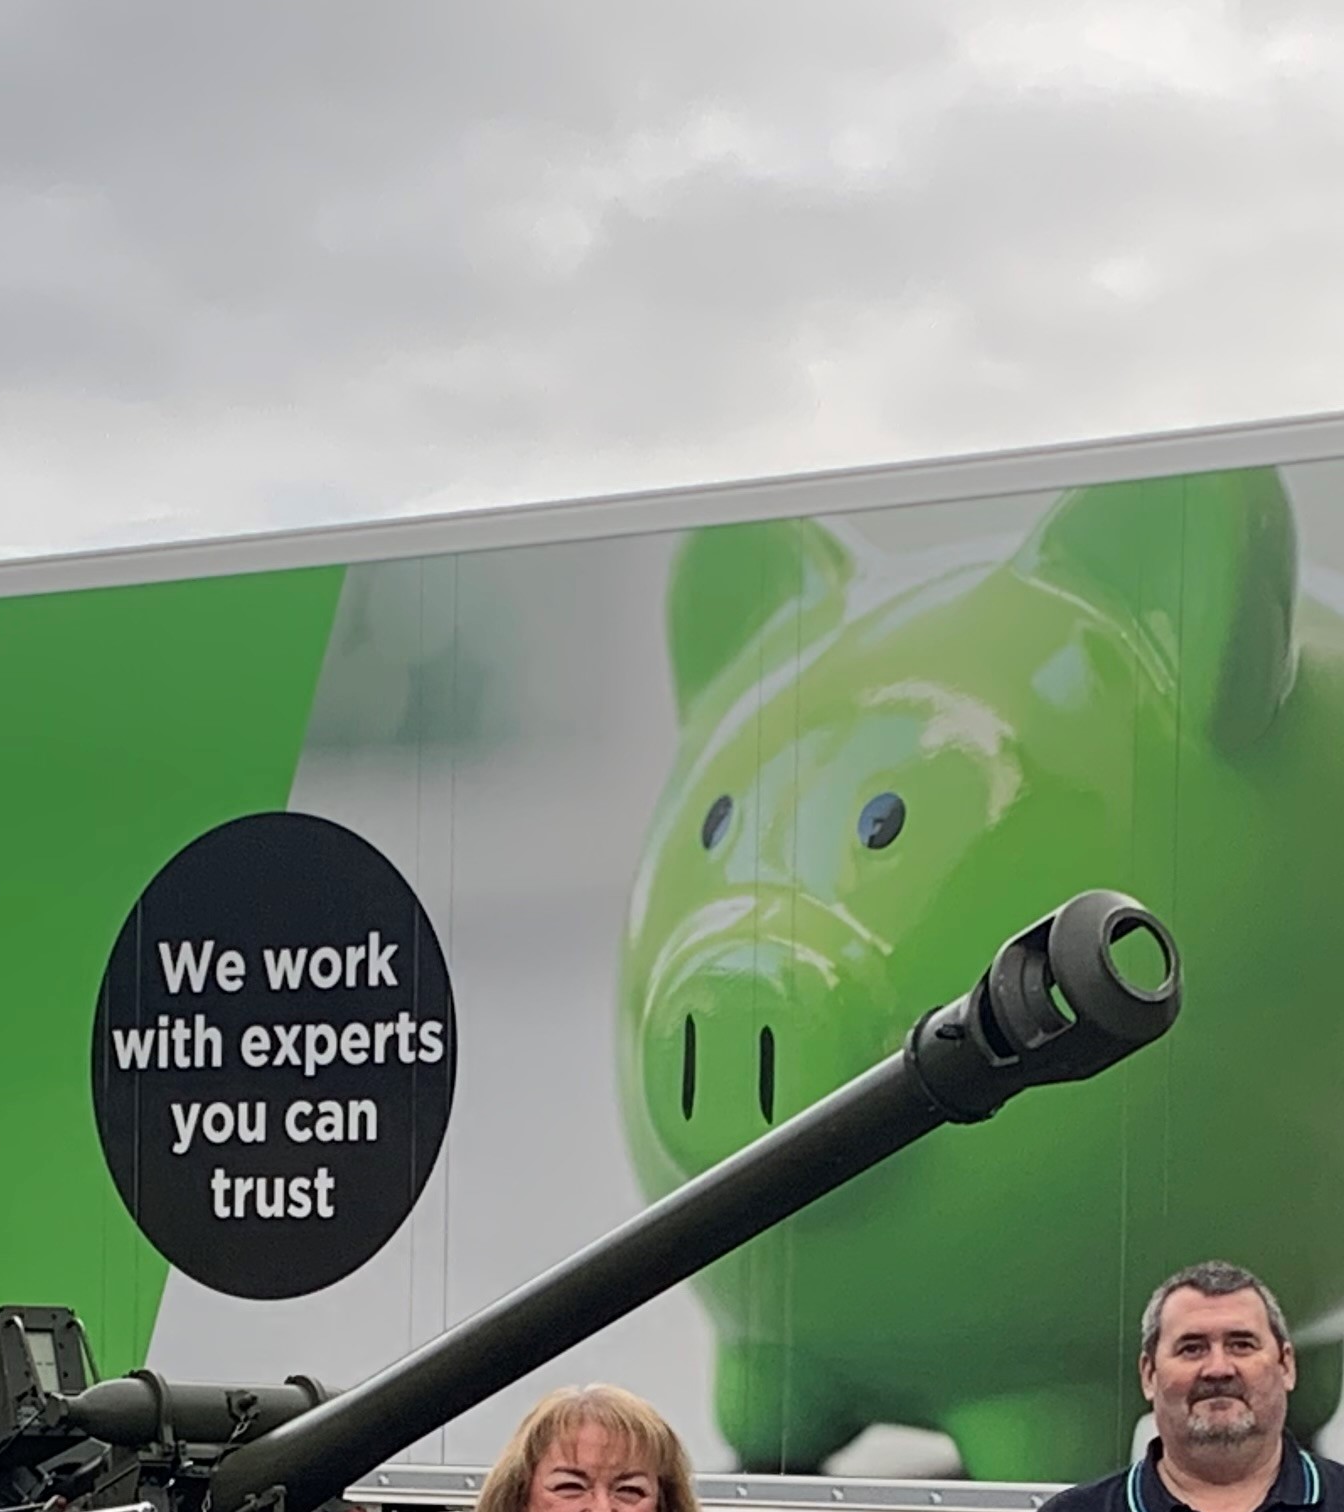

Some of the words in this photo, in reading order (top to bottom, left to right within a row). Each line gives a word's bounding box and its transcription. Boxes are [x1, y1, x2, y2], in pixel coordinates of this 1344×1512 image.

[158, 940, 246, 994] We
[263, 932, 399, 991] work
[112, 1014, 223, 1070] with
[241, 1012, 445, 1077] experts
[170, 1102, 268, 1155] you
[285, 1099, 379, 1143] can
[211, 1167, 336, 1219] trust
